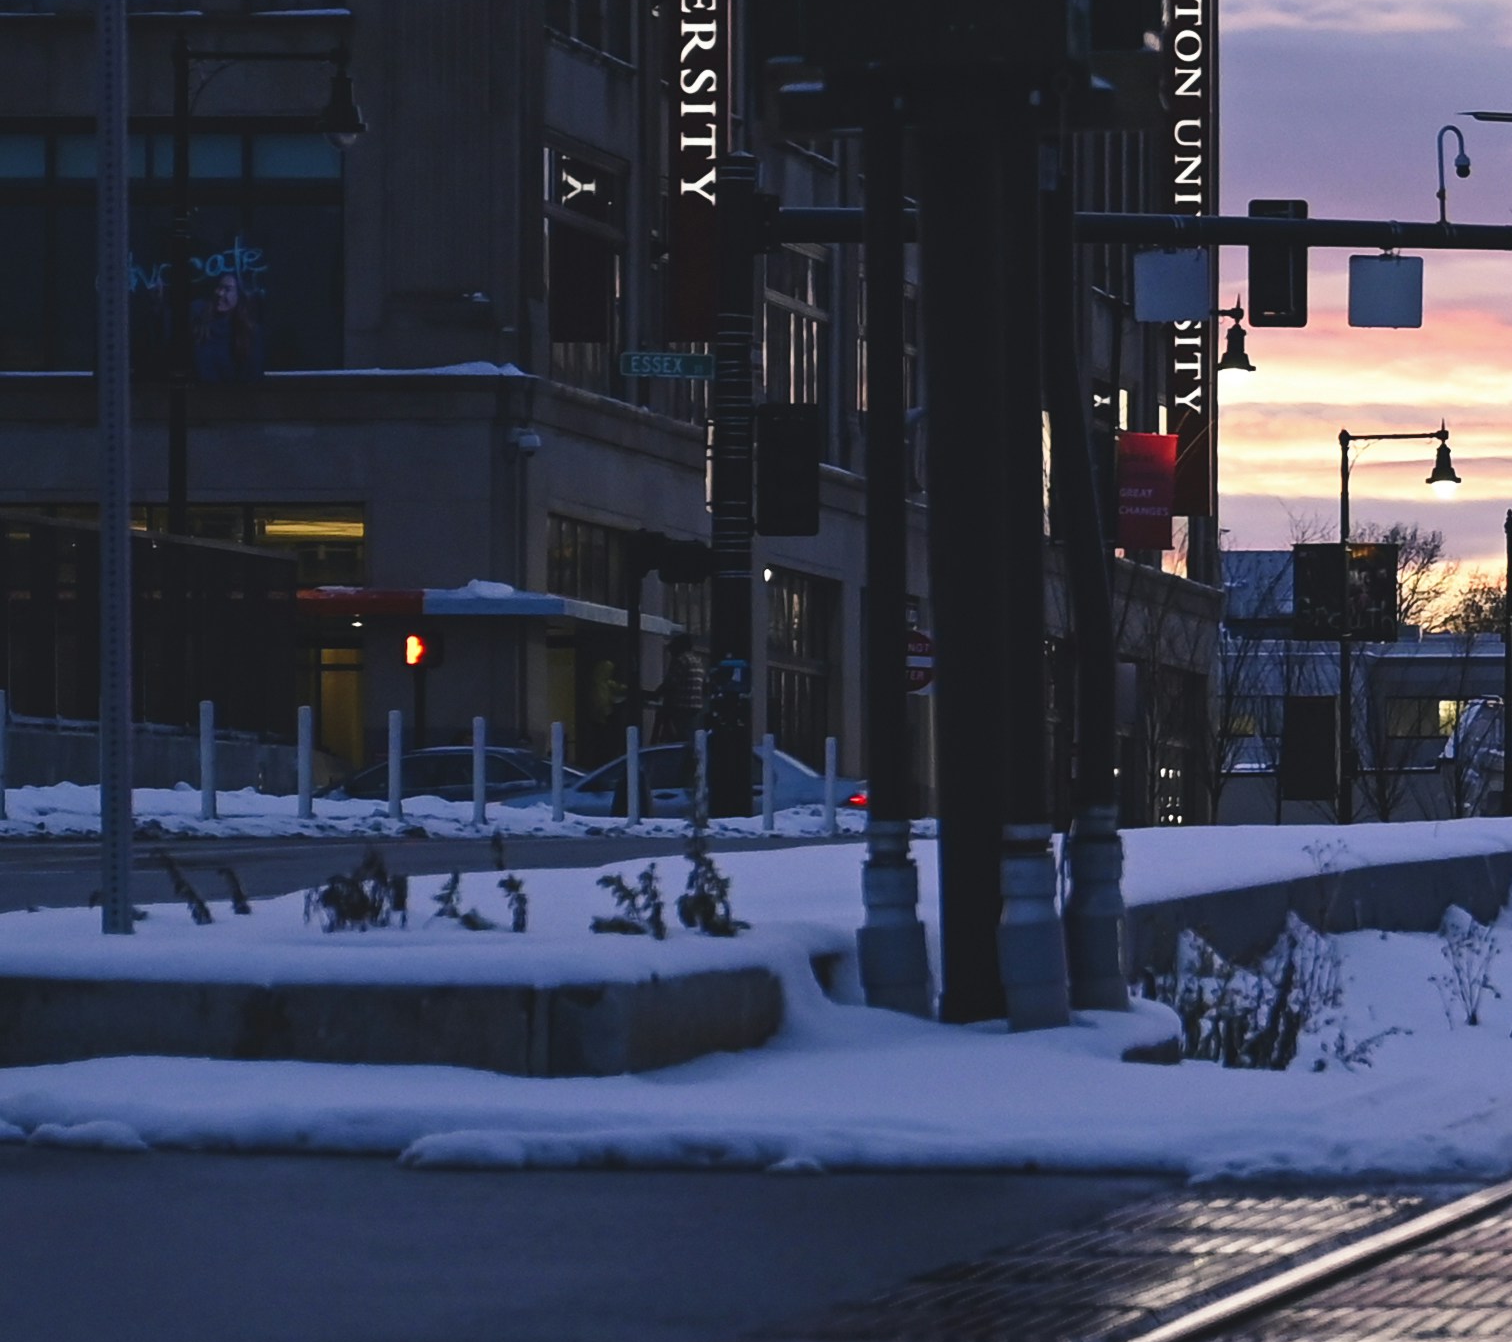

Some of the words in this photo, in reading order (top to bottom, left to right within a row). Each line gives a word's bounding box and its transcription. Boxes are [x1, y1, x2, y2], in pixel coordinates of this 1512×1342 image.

[1174, 118, 1204, 415] UNISITY
[631, 356, 683, 374] ESSEX
[1119, 488, 1153, 498] GREAT
[1119, 506, 1169, 516] CHANGES
